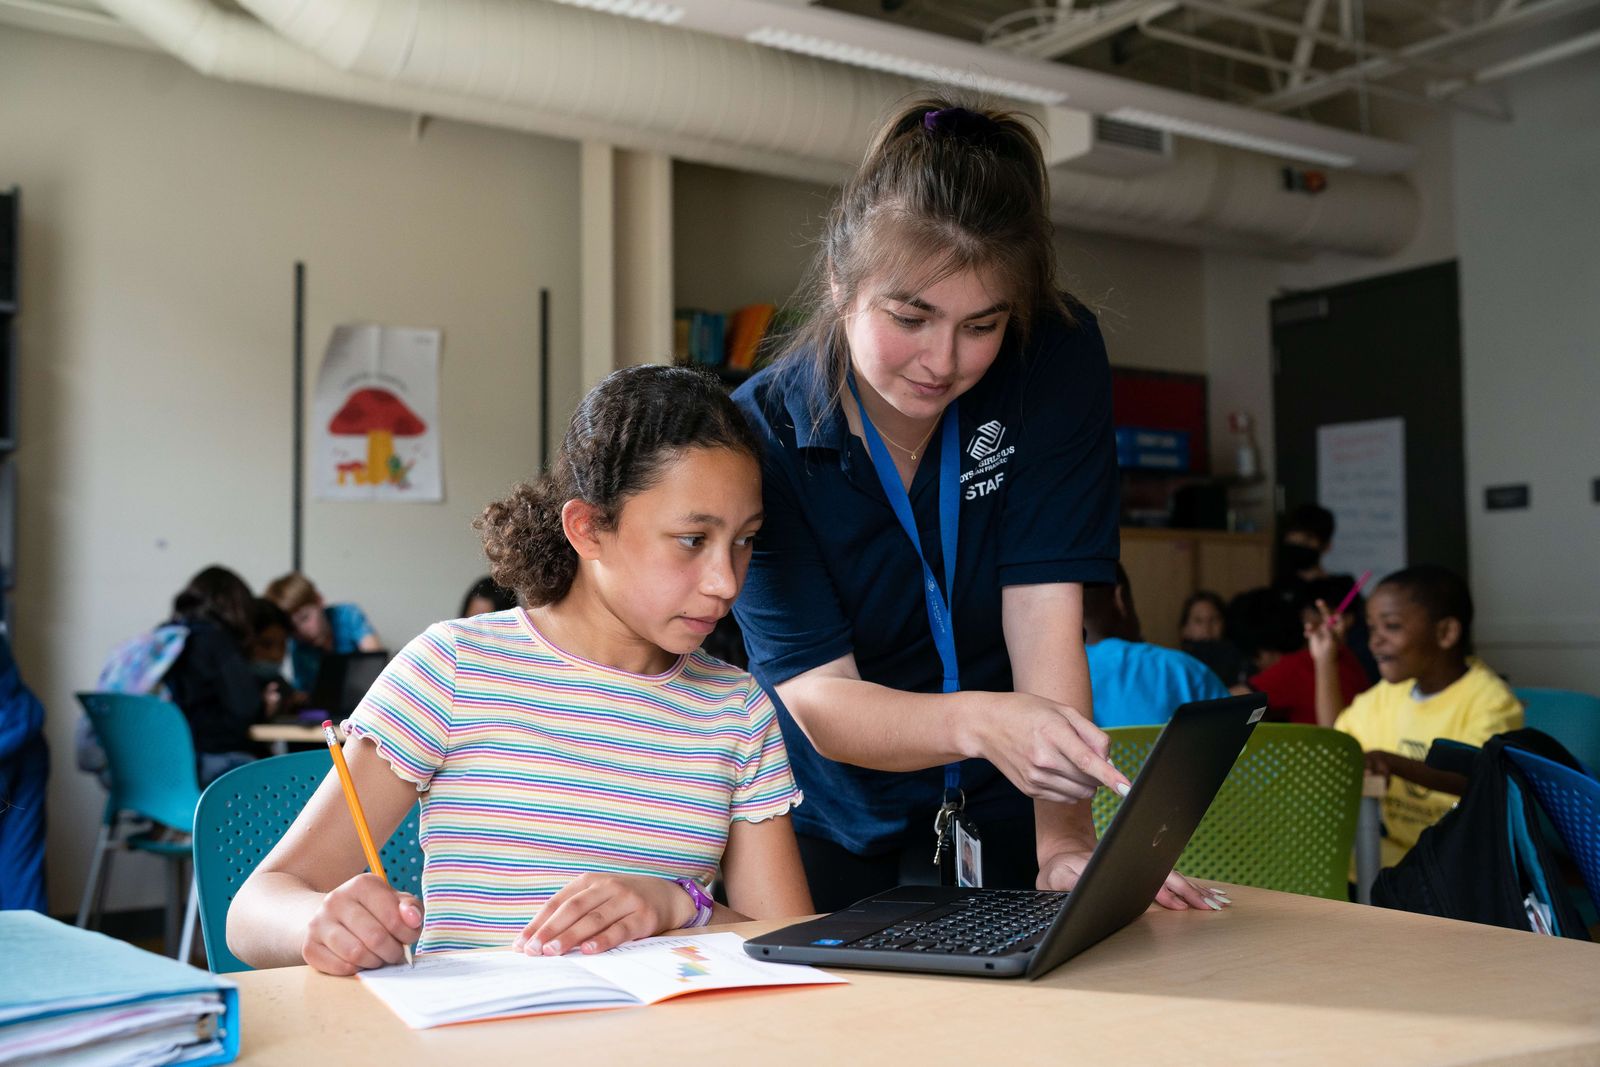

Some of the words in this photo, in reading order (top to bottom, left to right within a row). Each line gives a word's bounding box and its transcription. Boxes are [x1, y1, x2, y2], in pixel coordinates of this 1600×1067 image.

[960, 470, 974, 484] OYS
[978, 452, 1001, 467] GIRLS
[965, 472, 1004, 500] STAF
